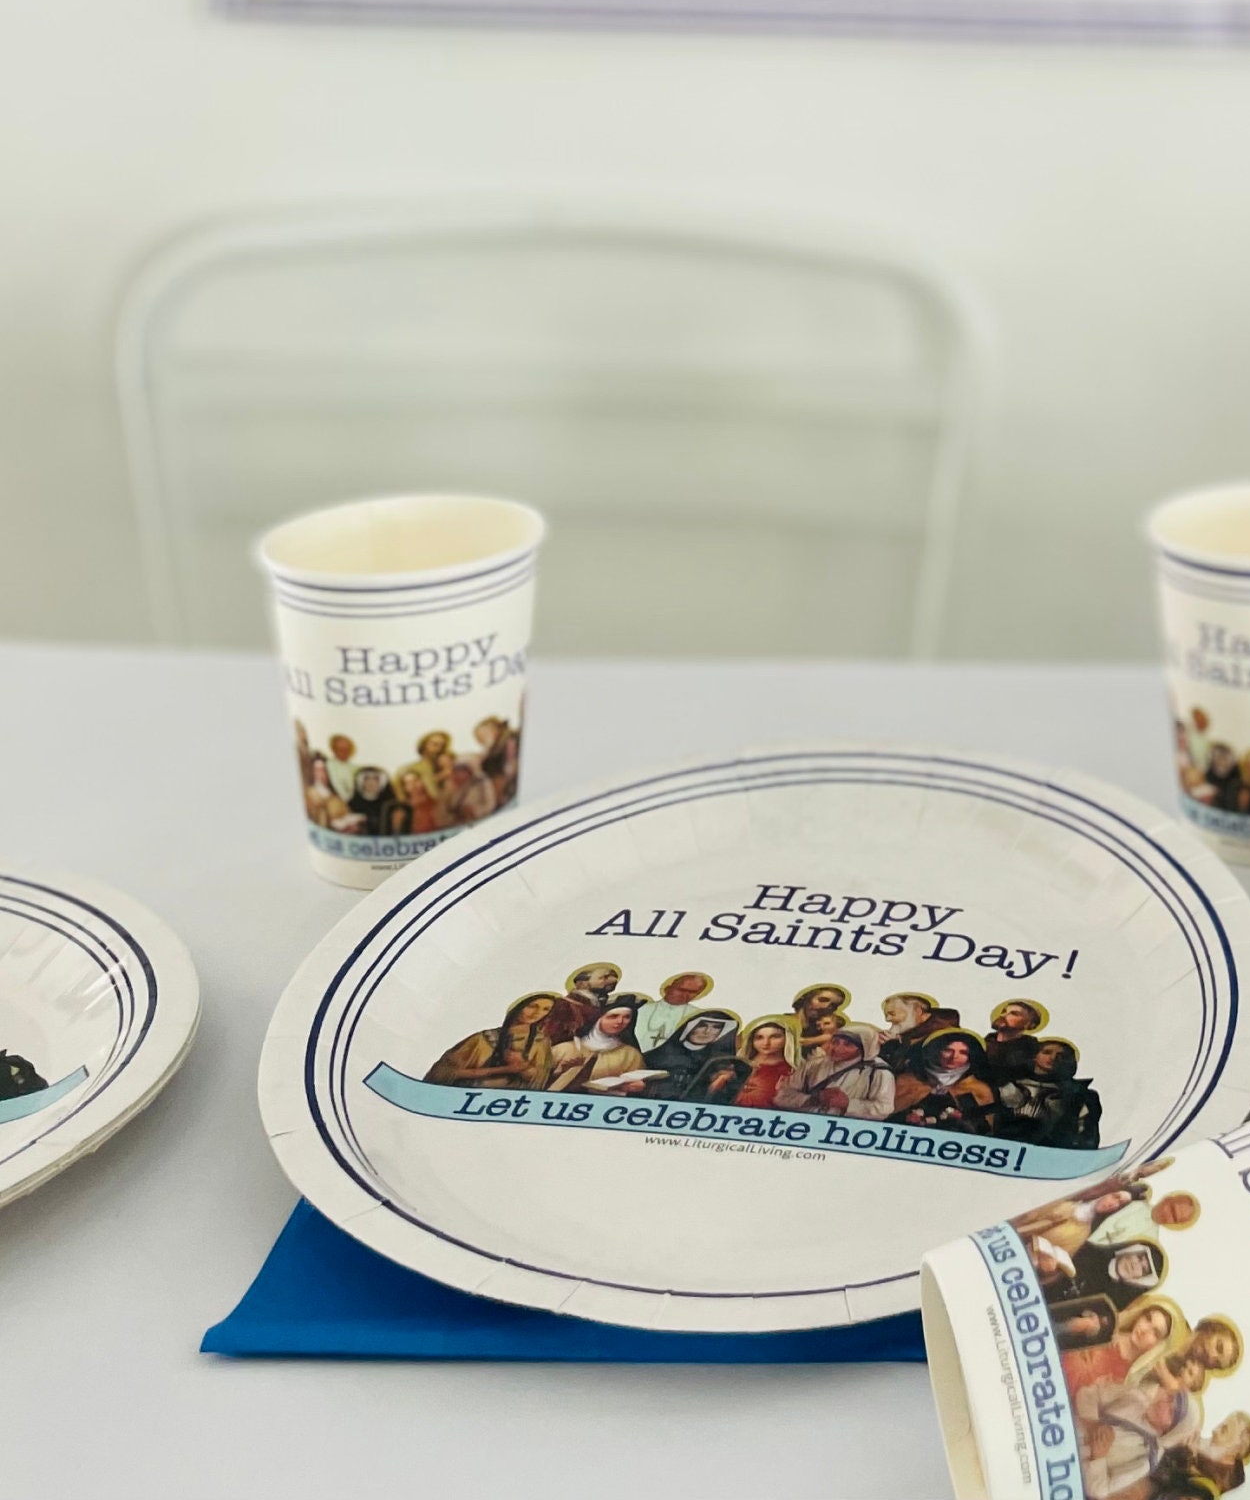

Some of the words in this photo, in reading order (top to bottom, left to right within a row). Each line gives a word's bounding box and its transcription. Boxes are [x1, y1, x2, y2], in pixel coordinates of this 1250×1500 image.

[335, 631, 498, 677] Happy
[324, 671, 472, 707] Saints
[743, 884, 963, 932] Happy
[586, 909, 687, 939] All
[699, 912, 909, 956] Saints
[922, 931, 1079, 980] Day!
[453, 1091, 529, 1119] Let
[542, 1102, 591, 1123] us
[603, 1104, 810, 1143] celebrate
[819, 1119, 1027, 1172] holiness!
[645, 1135, 827, 1162] www.LiturgicalLiving.com
[988, 1236, 1017, 1264] us
[1001, 1266, 1065, 1448] celebrate
[986, 1305, 1031, 1484] www.LiturgicalLiving.com
